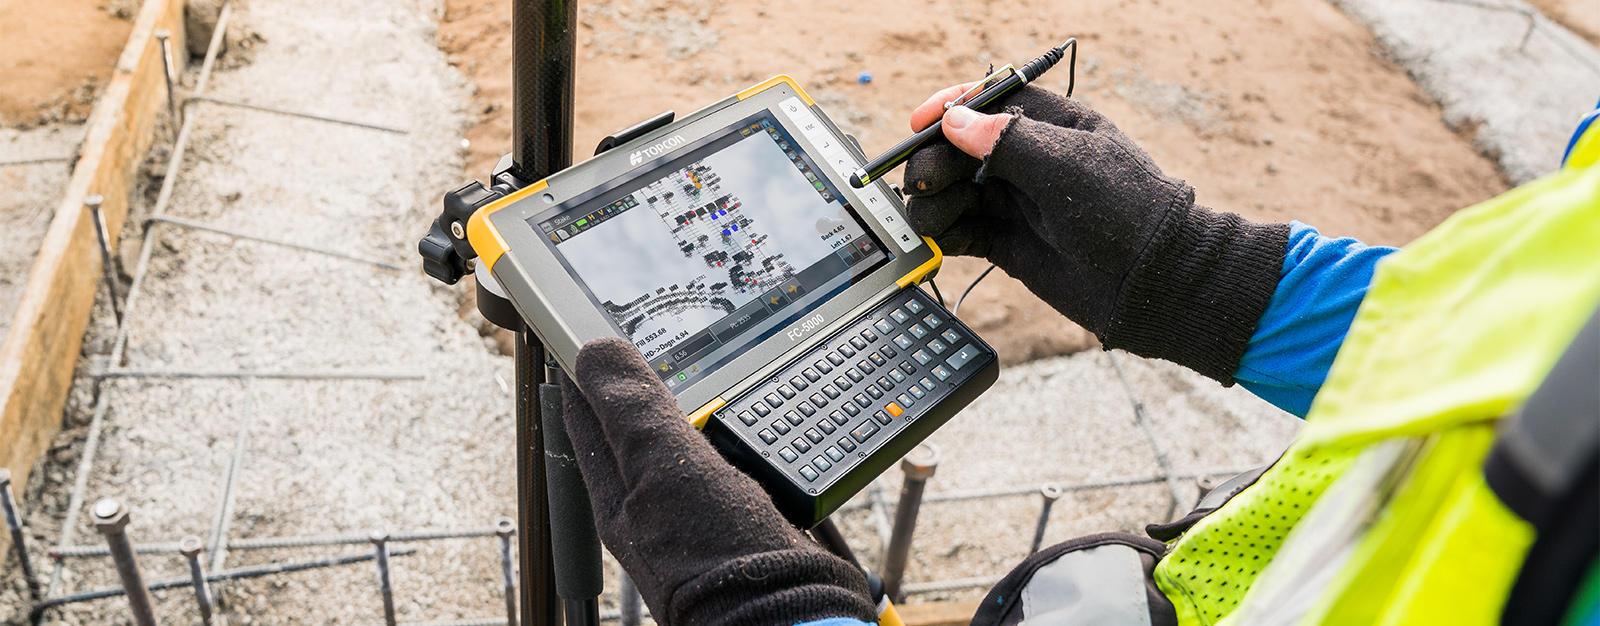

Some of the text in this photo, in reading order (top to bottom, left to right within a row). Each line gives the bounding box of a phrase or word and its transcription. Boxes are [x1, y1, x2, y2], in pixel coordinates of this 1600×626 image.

[804, 123, 815, 131] ESC
[641, 134, 686, 158] TOPCON
[554, 214, 571, 226] Stake
[820, 224, 845, 241] Back 4.65
[831, 240, 842, 250] Left
[787, 314, 824, 341] FC-5000
[635, 328, 667, 348] Fill 553.68
[675, 330, 689, 341] 4.94
[674, 350, 688, 361] 6.56
